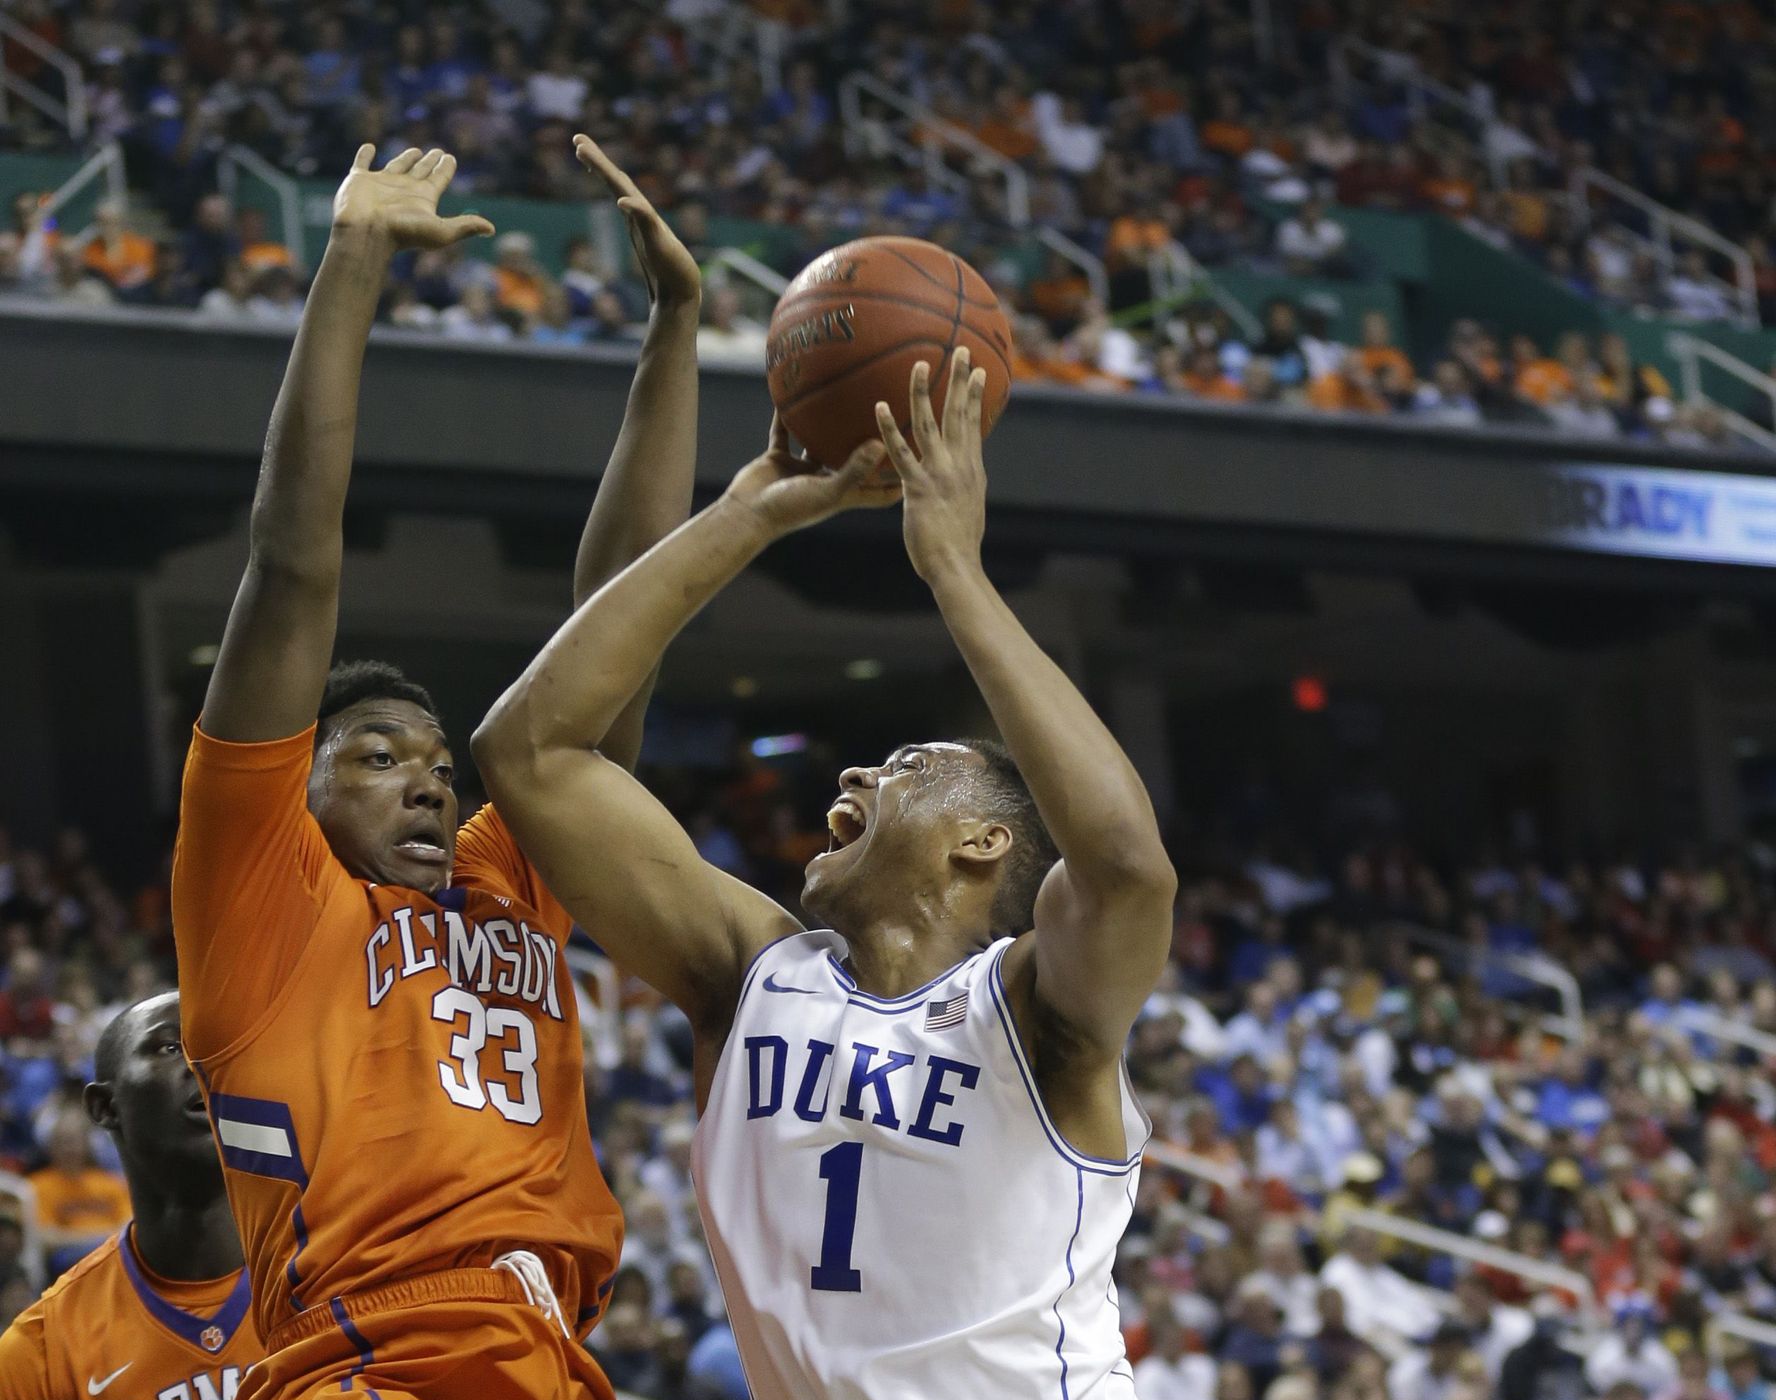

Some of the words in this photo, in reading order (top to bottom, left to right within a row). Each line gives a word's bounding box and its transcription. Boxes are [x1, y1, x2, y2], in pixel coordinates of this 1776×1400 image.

[430, 985, 544, 1127] 33
[744, 1034, 981, 1148] DUKE
[810, 1140, 865, 1294] 1
